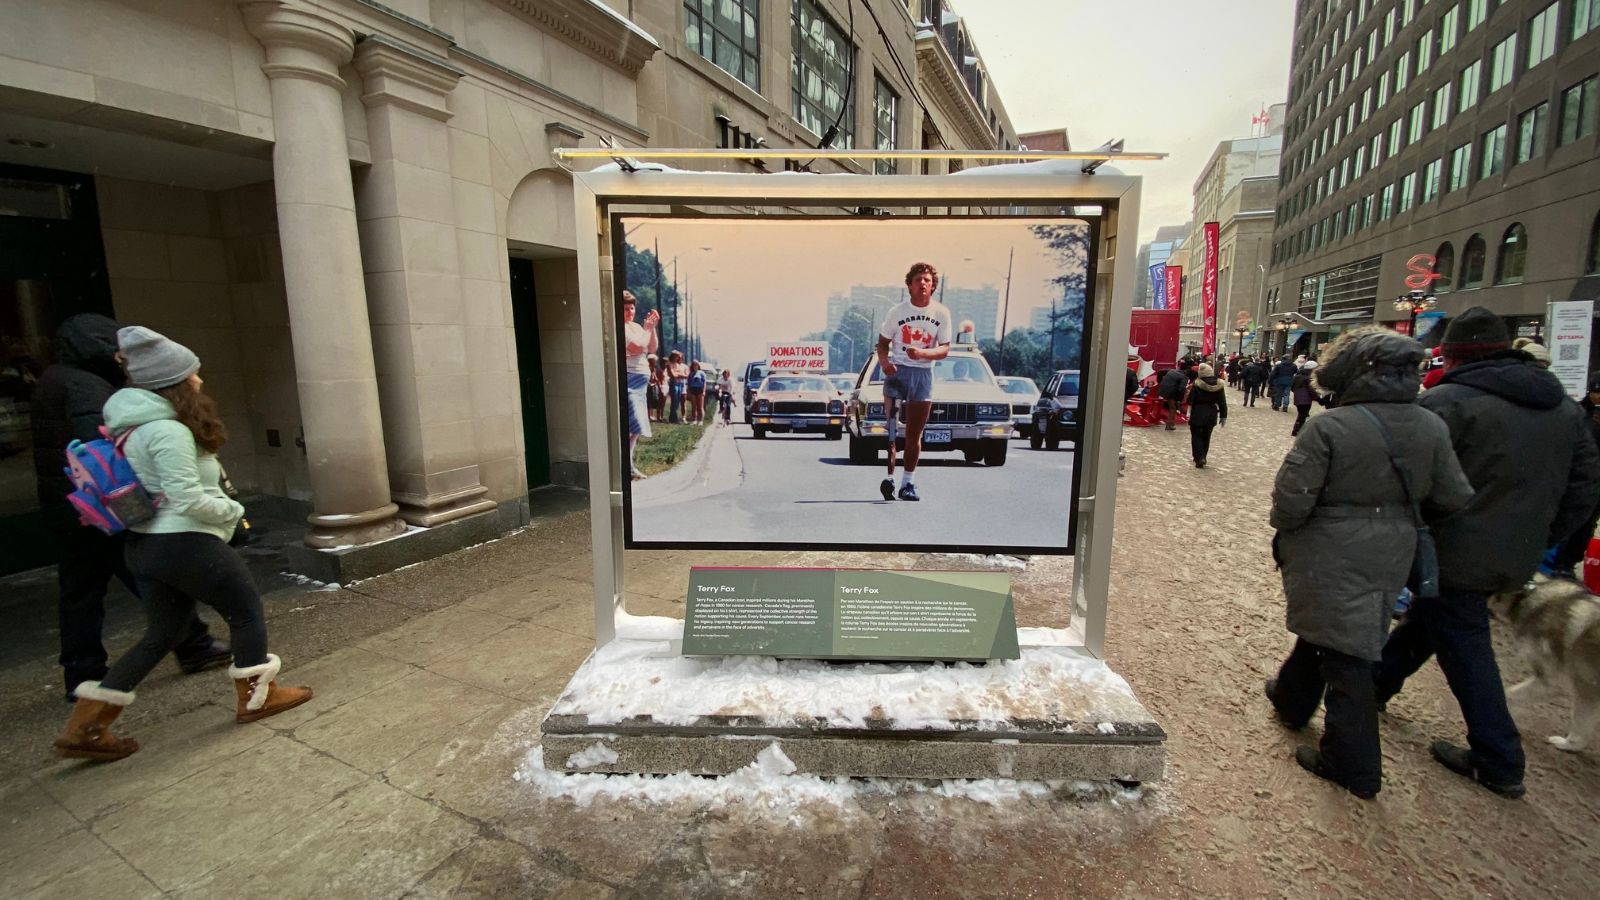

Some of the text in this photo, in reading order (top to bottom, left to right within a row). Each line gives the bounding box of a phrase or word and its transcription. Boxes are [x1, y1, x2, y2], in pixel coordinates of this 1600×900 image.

[898, 315, 941, 327] MARATHON
[770, 346, 824, 357] DONATIONS
[770, 359, 825, 368] ACCEPTED HERE
[697, 585, 719, 594] Terry
[840, 586, 879, 595] Terry Fox
